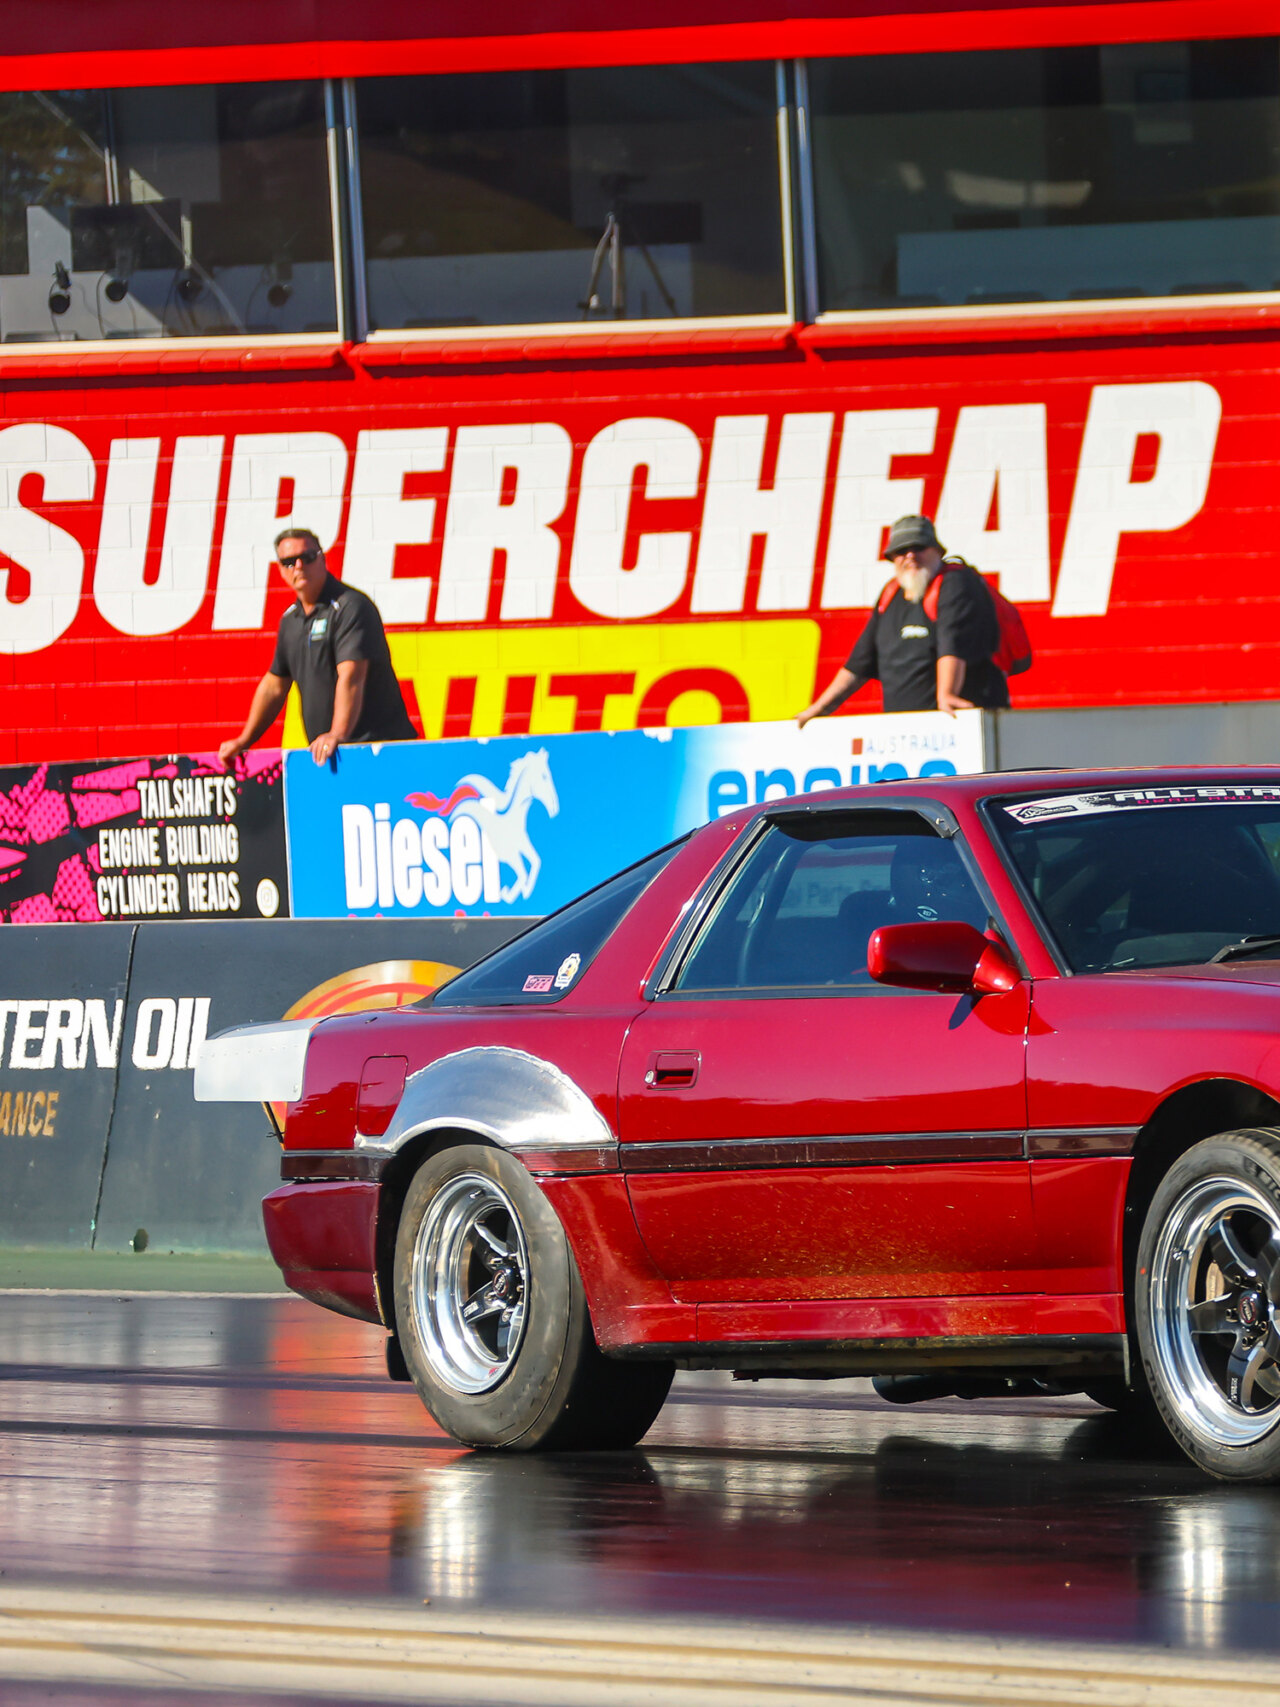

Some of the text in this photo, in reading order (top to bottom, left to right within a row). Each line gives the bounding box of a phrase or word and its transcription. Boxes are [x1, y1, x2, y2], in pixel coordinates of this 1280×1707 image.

[0, 380, 1222, 655] SUPERCHEAP
[866, 734, 957, 755] AUSTRALIA
[137, 776, 238, 819] TAILSHAFTS
[99, 823, 239, 868] ENGINE BUILDING
[342, 800, 502, 910] Diesel
[97, 871, 241, 916] CYLINDER HEADS
